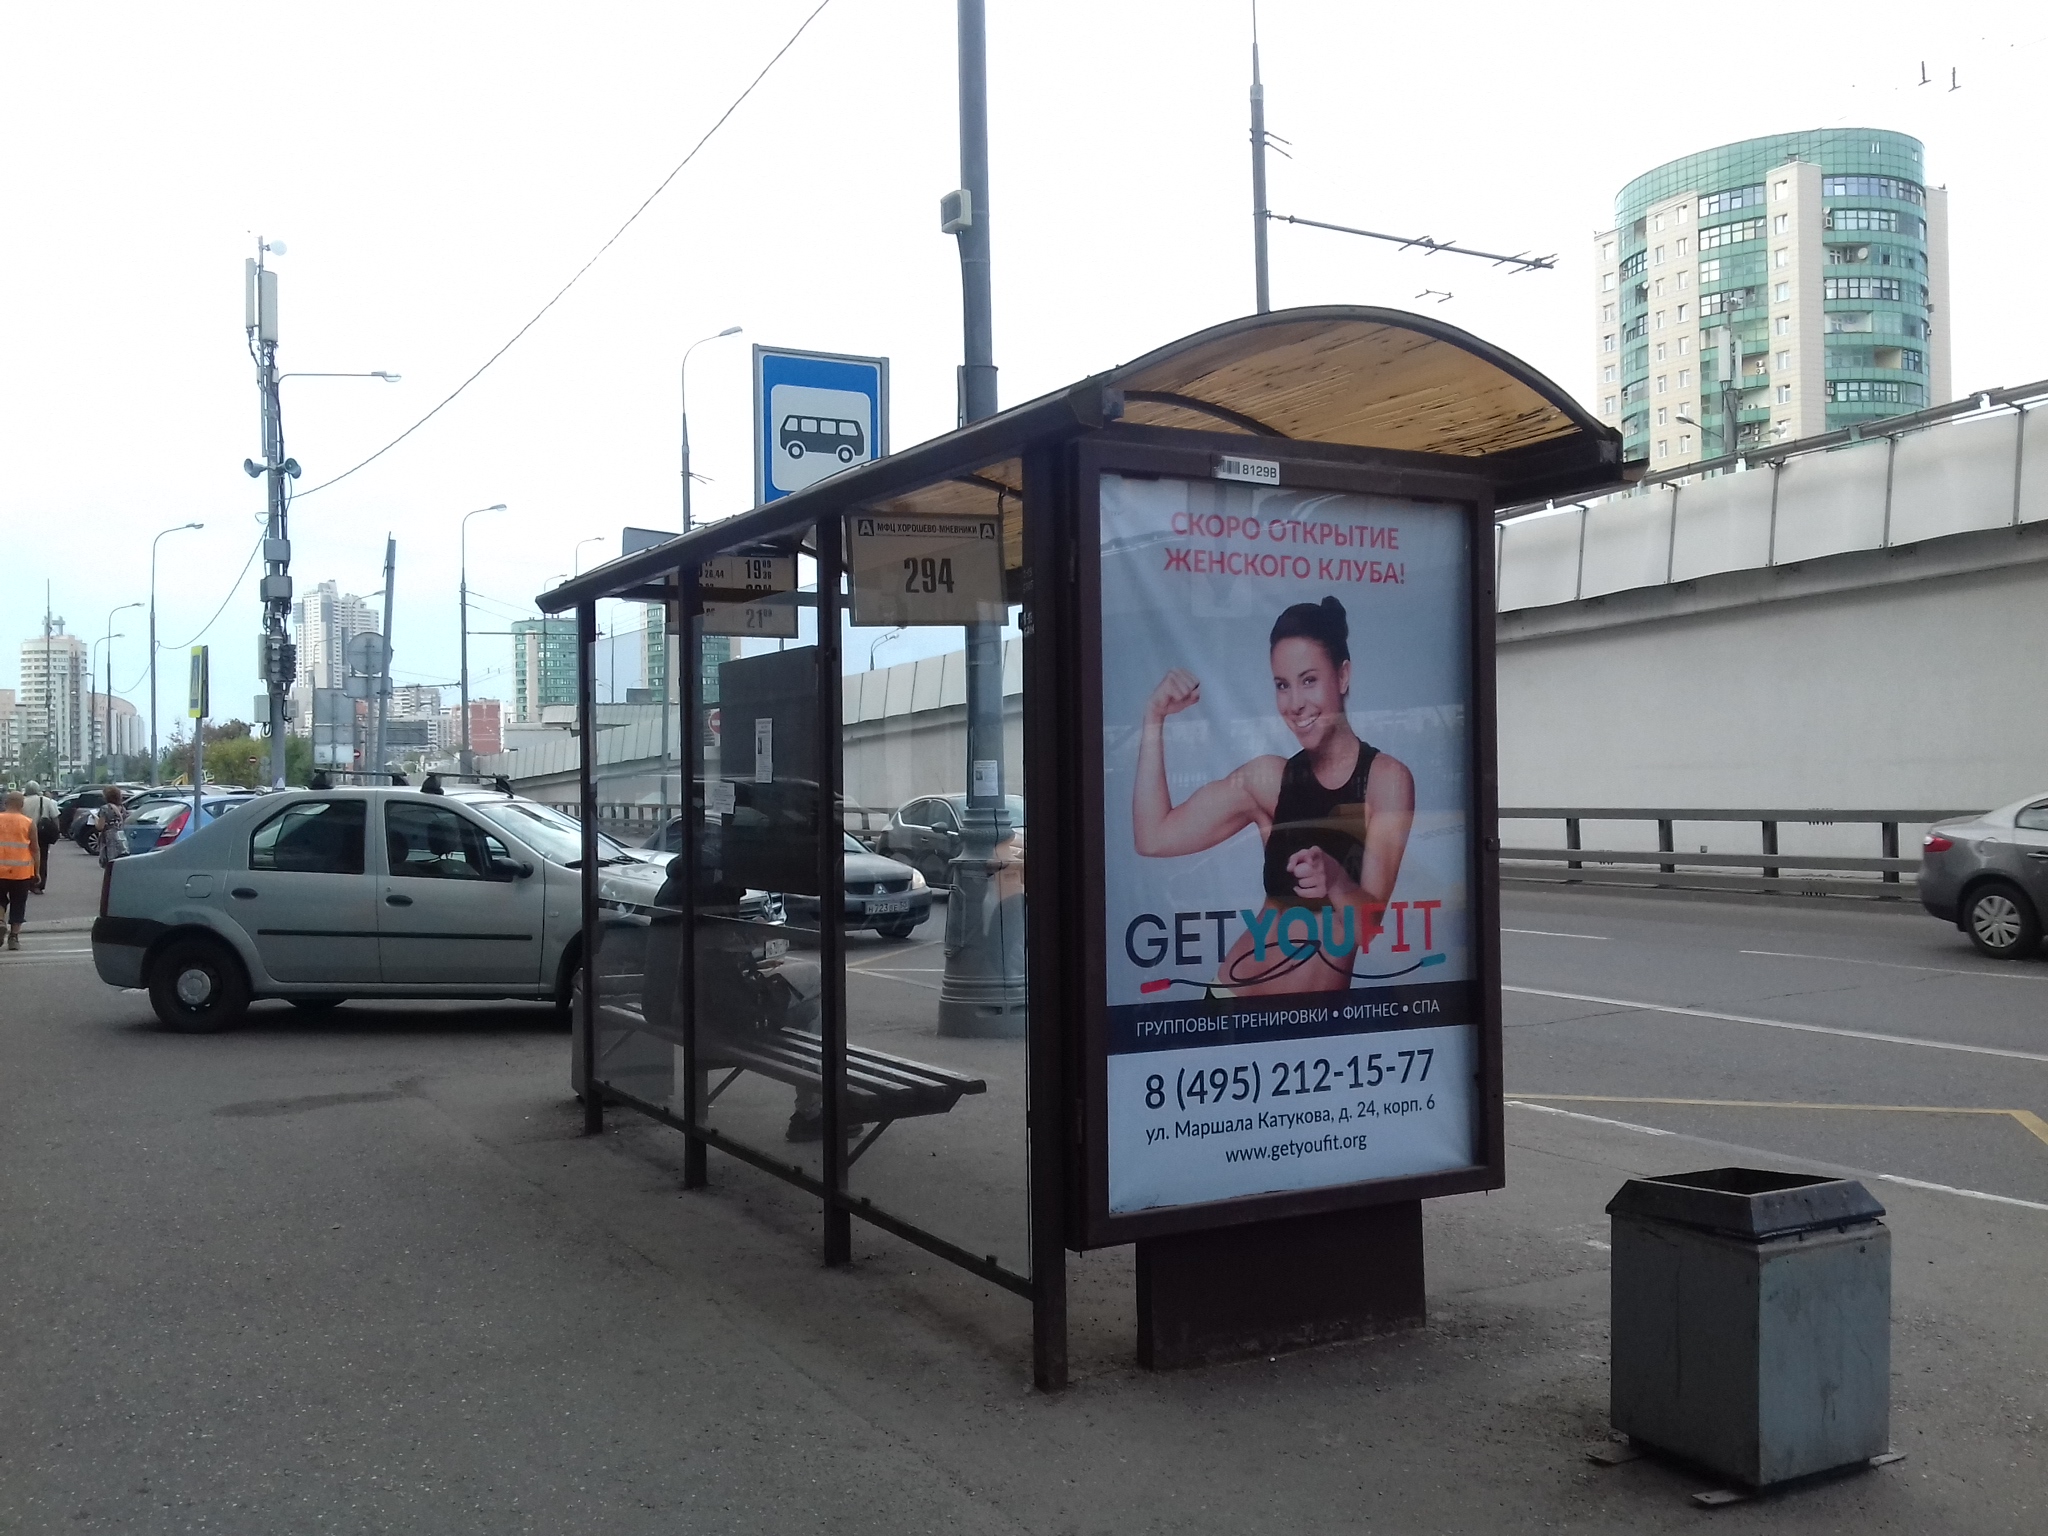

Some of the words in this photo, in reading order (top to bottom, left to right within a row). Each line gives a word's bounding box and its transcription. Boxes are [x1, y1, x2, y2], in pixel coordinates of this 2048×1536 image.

[1242, 464, 1277, 478] 8129B
[877, 522, 896, 533] МФЦ
[1170, 512, 1261, 541] СКОРО
[1268, 518, 1400, 550] ОТКРЫТИЕ
[745, 559, 761, 579] 19
[904, 557, 954, 594] 294
[1164, 548, 1309, 579] ЖЕНСКОГО
[1319, 558, 1406, 585] КЛУБА!
[746, 608, 763, 628] 21
[1125, 900, 1442, 969] GETYOUFIT
[1137, 1014, 1229, 1037] ГРУППОВЫЕ
[1232, 1007, 1329, 1029] ТРЕНИРОВКИ
[1343, 1002, 1399, 1021] ФИТНЕС
[1413, 999, 1441, 1015] СПА
[1145, 1073, 1166, 1110] 8
[1176, 1061, 1262, 1111] (495)
[1271, 1048, 1435, 1097] 212-15-77
[1146, 1126, 1170, 1145] ул.
[1175, 1116, 1253, 1140] Маршала
[1258, 1107, 1335, 1132] Катукова,
[1338, 1106, 1353, 1124] д.
[1357, 1100, 1380, 1120] 24,
[1383, 1098, 1423, 1118] корп.
[1427, 1093, 1436, 1111] 6
[1225, 1132, 1368, 1164] www.getyoufit.org
